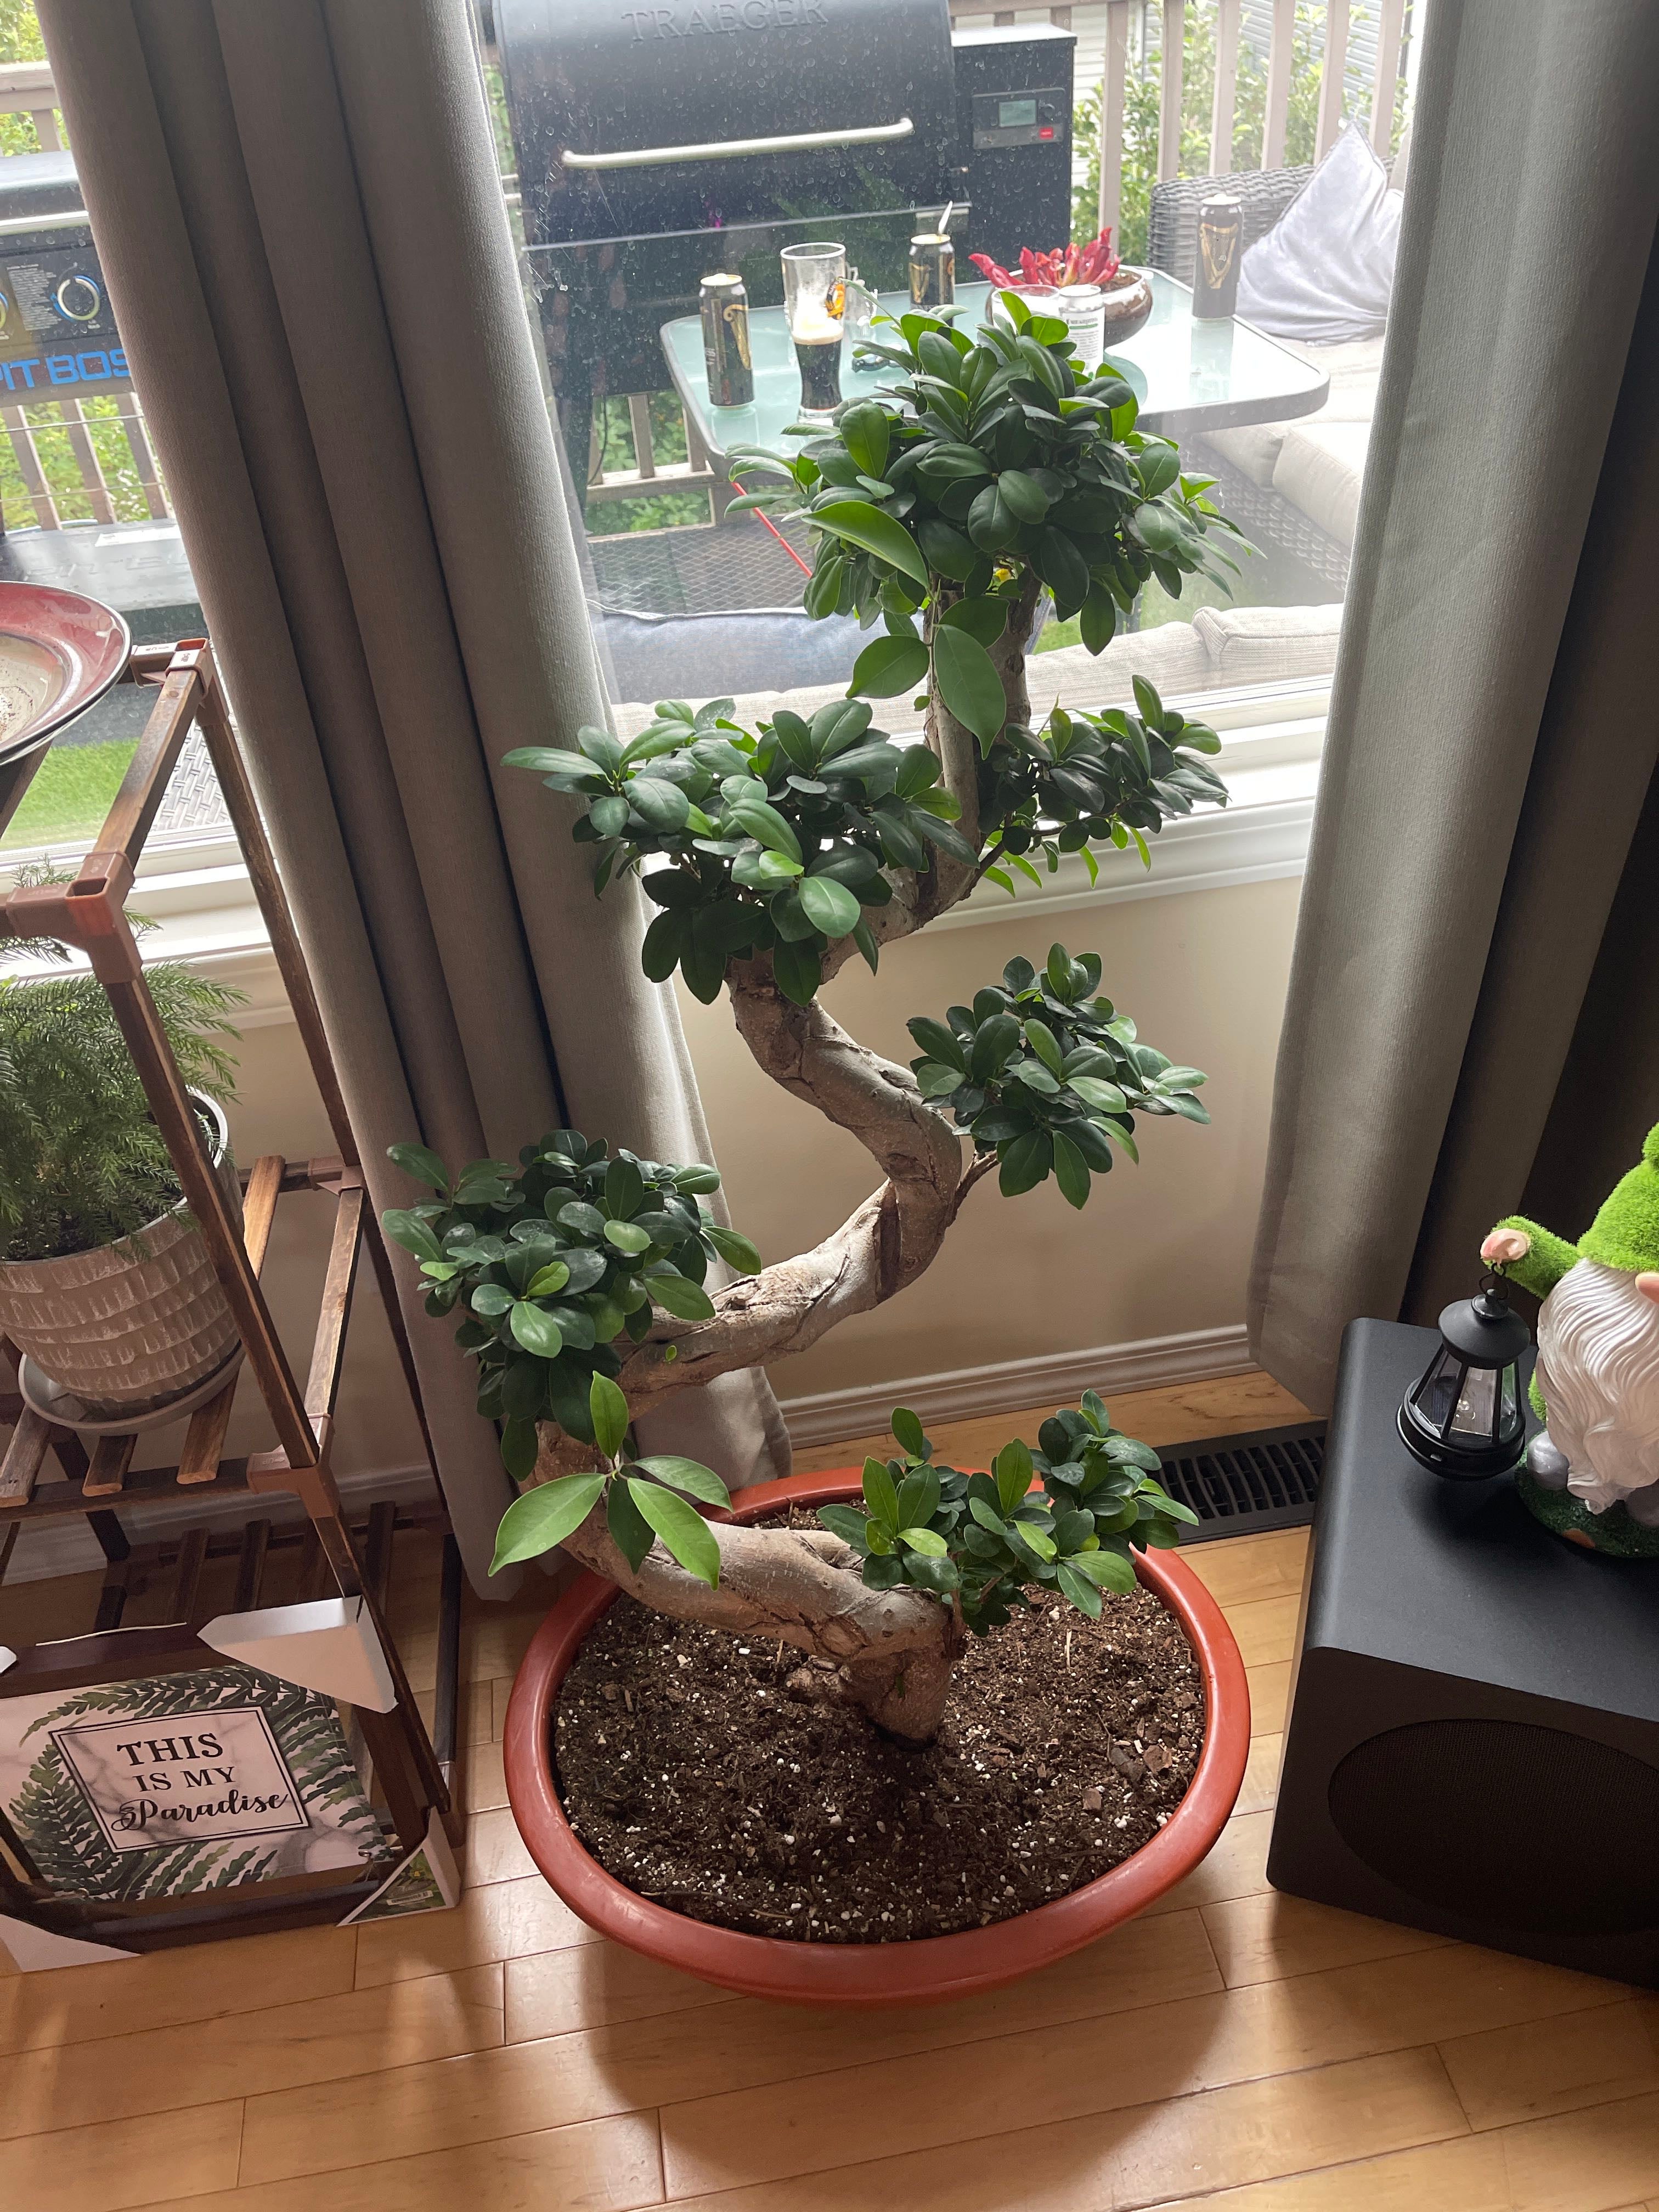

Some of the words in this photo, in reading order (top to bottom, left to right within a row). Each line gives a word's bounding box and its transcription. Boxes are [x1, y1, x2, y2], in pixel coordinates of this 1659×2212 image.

[620, 0, 829, 42] TRAEGER
[0, 359, 40, 390] IT
[117, 1733, 223, 1766] THIS
[132, 1773, 172, 1792] IS
[180, 1767, 235, 1788] MY
[111, 1789, 289, 1831] Paradise
